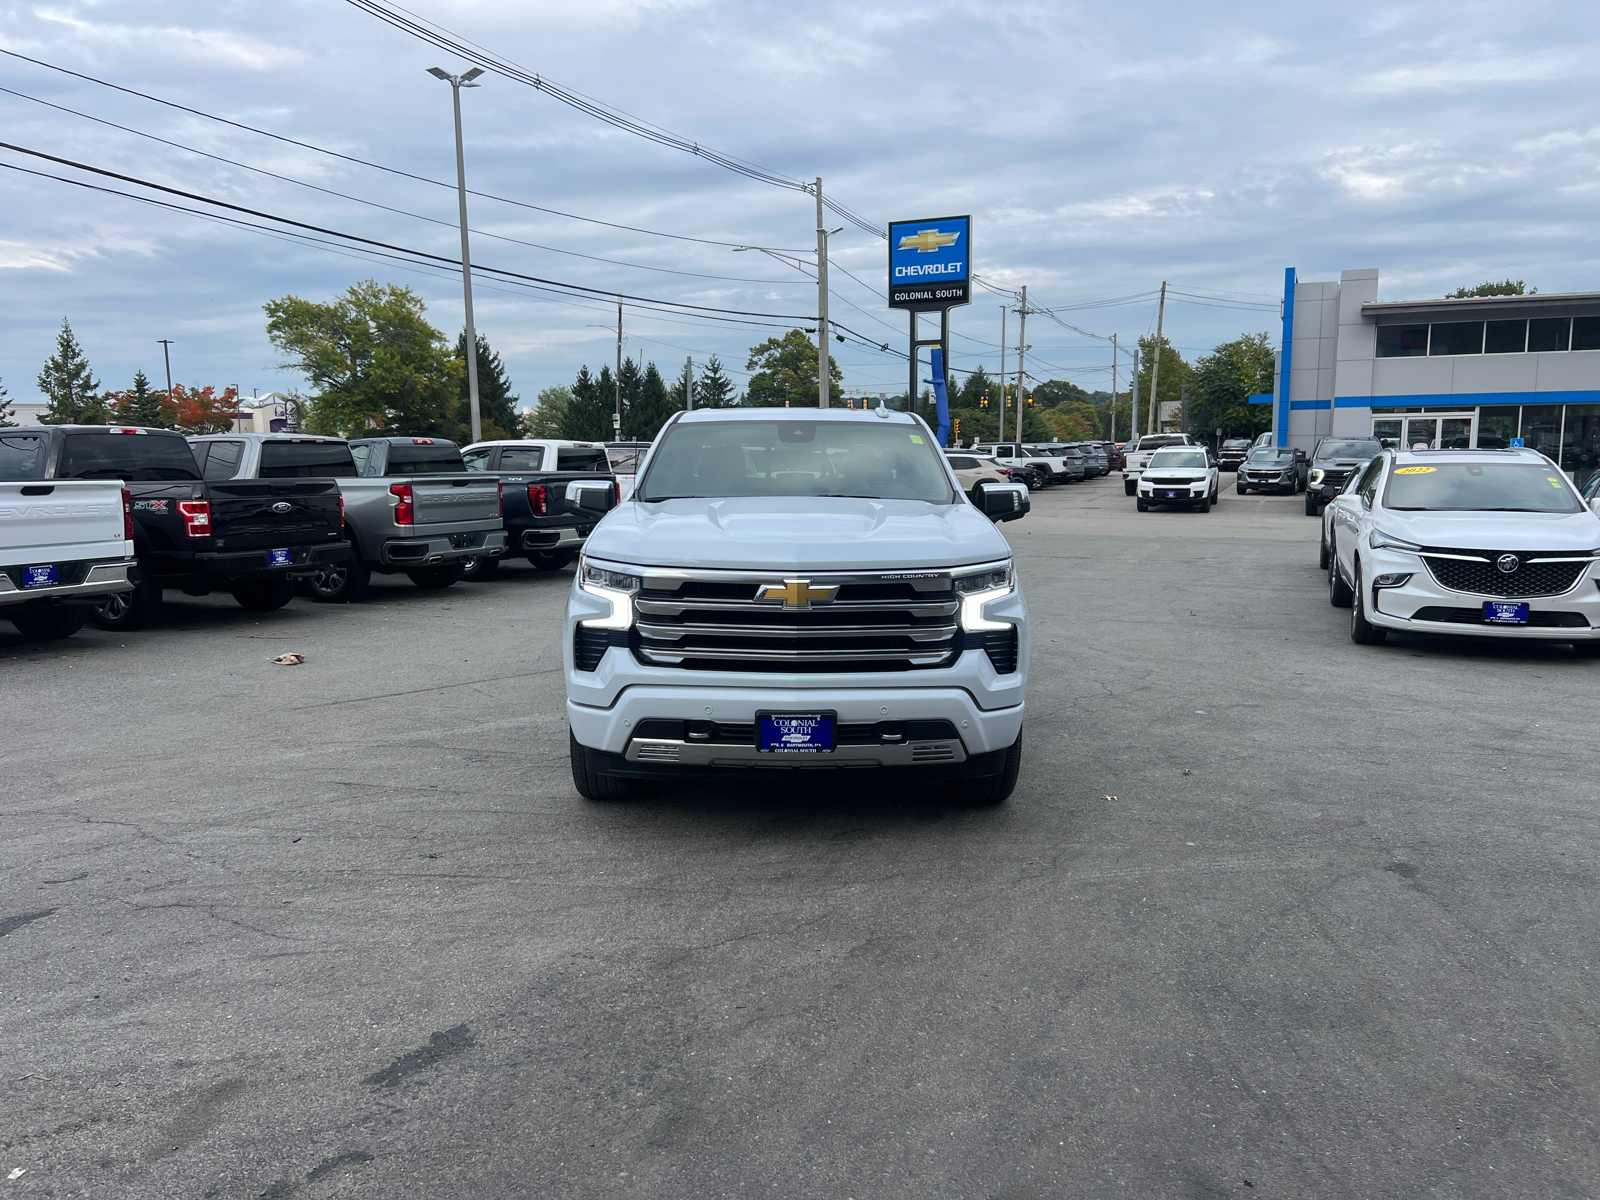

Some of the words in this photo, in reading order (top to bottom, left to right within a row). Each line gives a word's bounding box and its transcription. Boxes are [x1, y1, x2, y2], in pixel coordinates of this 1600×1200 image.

[895, 262, 962, 277] CHEVROLET
[894, 290, 933, 301] COLONIAL
[935, 289, 963, 298] SOUTH
[133, 500, 168, 511] STX
